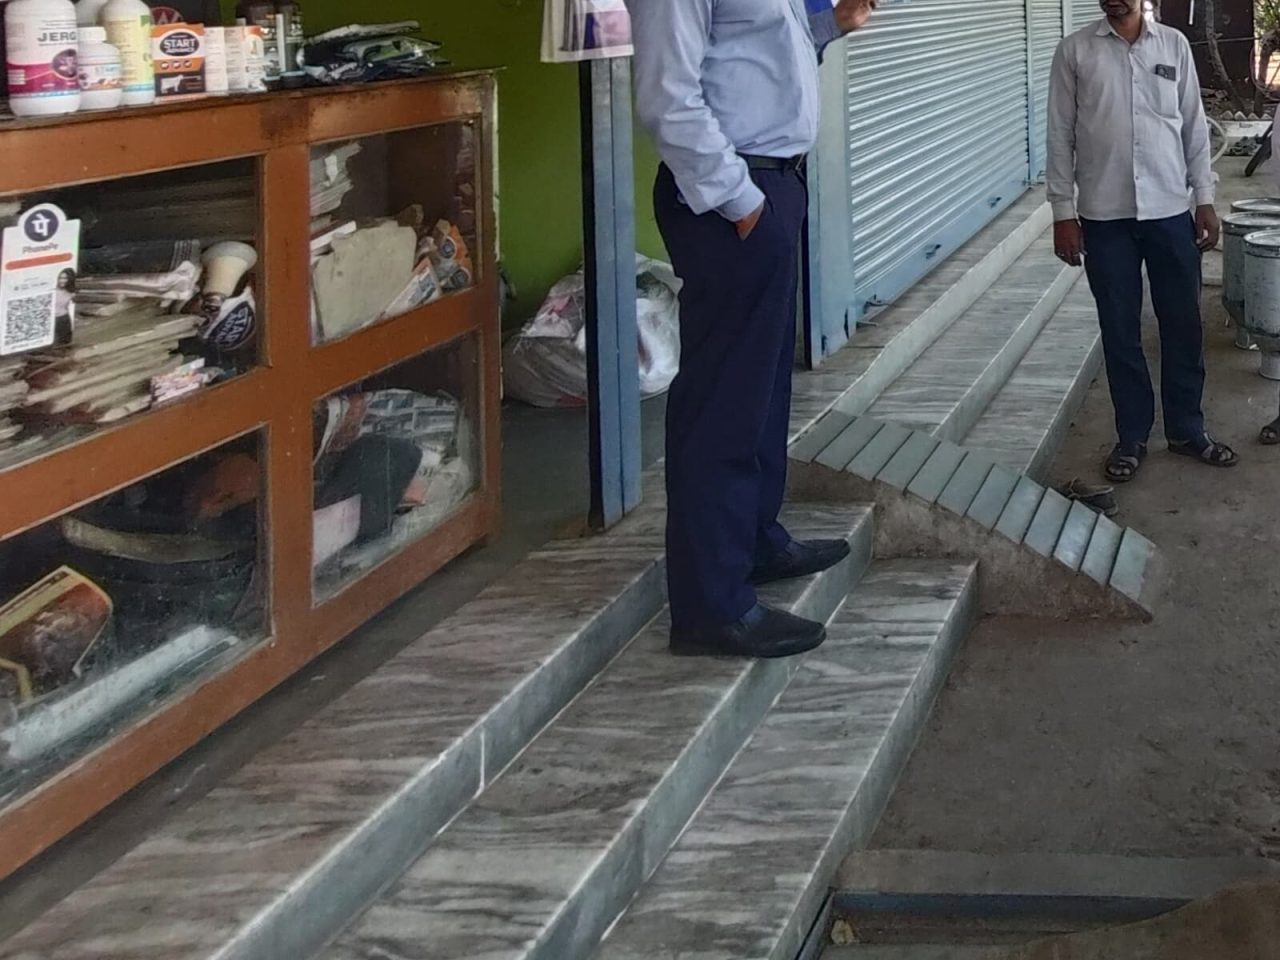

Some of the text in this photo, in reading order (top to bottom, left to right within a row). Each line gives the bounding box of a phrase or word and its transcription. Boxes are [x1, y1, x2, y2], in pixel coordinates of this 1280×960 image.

[163, 38, 196, 49] START
[31, 212, 51, 237] पे
[22, 242, 59, 255] PhonePe
